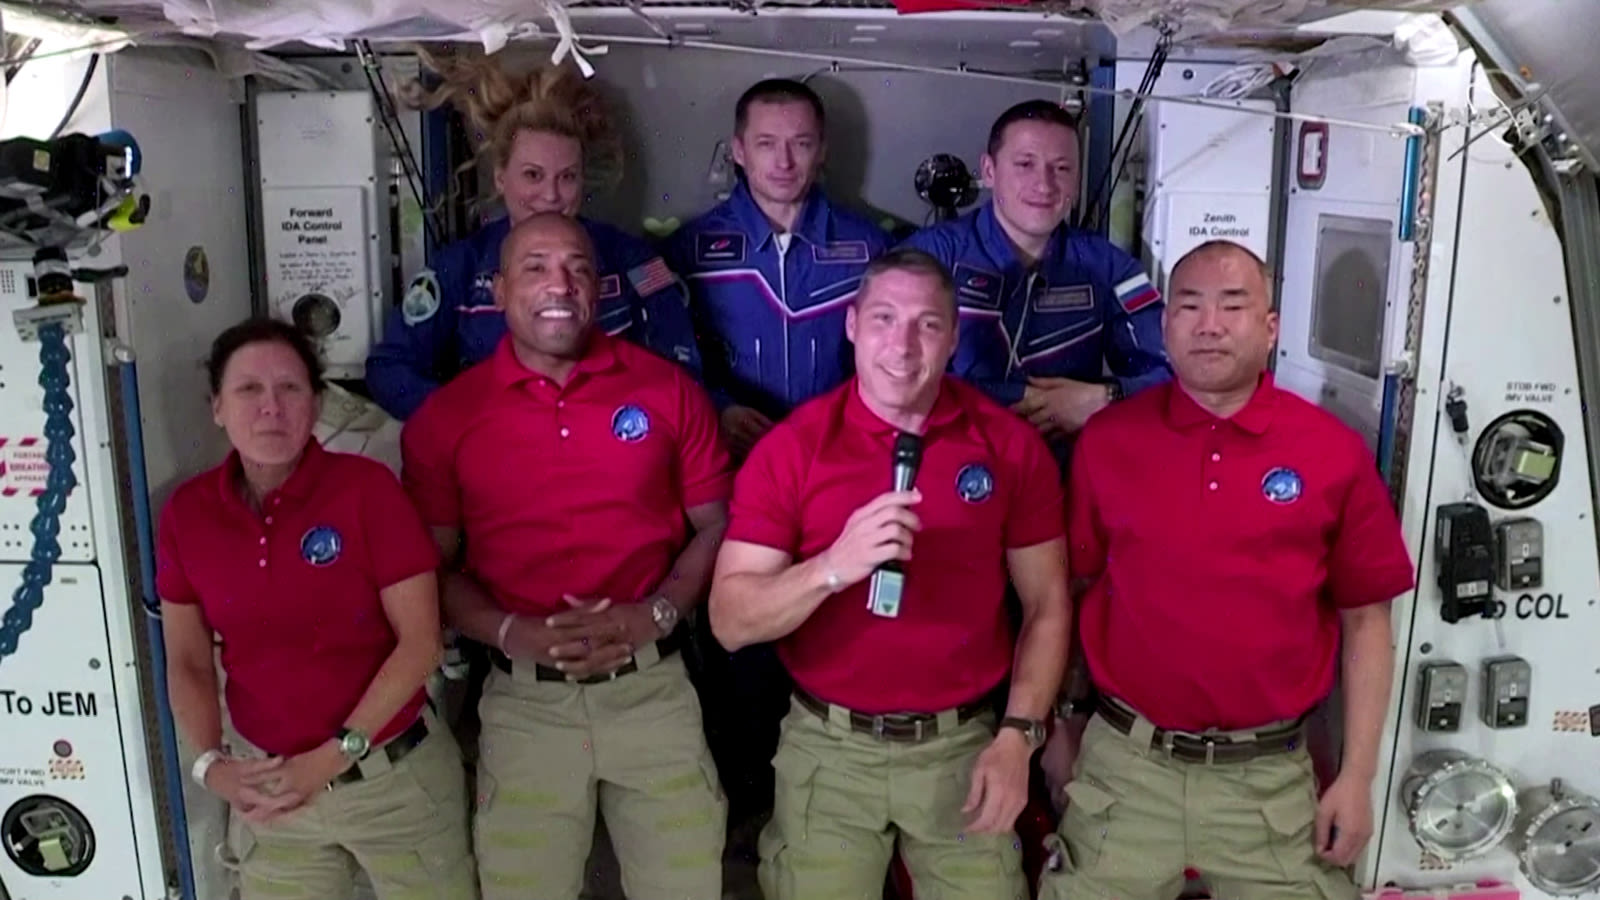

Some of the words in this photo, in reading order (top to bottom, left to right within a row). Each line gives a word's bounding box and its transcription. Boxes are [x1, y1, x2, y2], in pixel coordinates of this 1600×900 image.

[289, 207, 334, 217] Forward
[1203, 213, 1236, 222] Zenith
[281, 222, 300, 231] IDA
[303, 220, 343, 231] Control
[1189, 227, 1208, 236] IDA
[1210, 227, 1249, 236] Control
[298, 235, 327, 244] Panel
[1524, 393, 1553, 403] VALVE
[1515, 593, 1569, 619] COL
[0, 689, 33, 716] To
[41, 691, 97, 717] JEM
